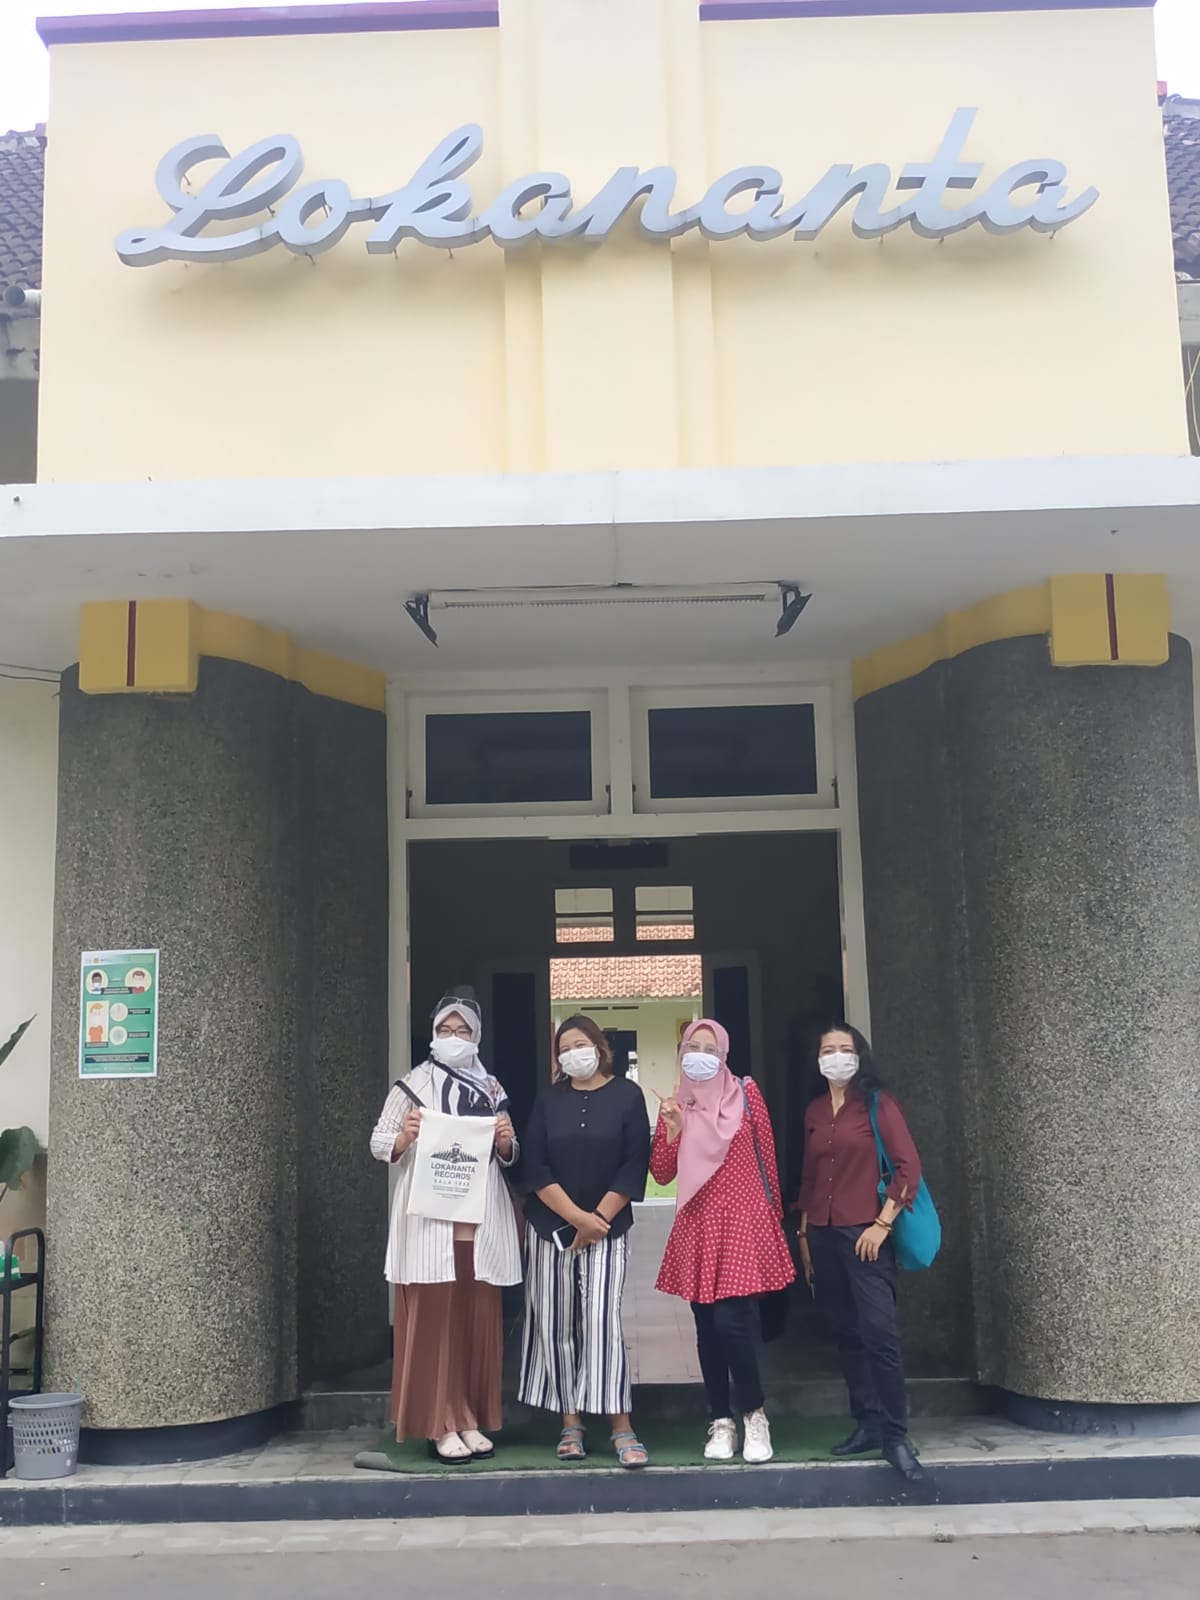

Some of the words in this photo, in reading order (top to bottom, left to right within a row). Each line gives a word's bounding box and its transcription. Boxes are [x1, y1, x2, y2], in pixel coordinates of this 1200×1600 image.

[116, 107, 1099, 269] Lokananta
[431, 1162, 475, 1173] LOKANANTA
[434, 1170, 471, 1180] RECORDS
